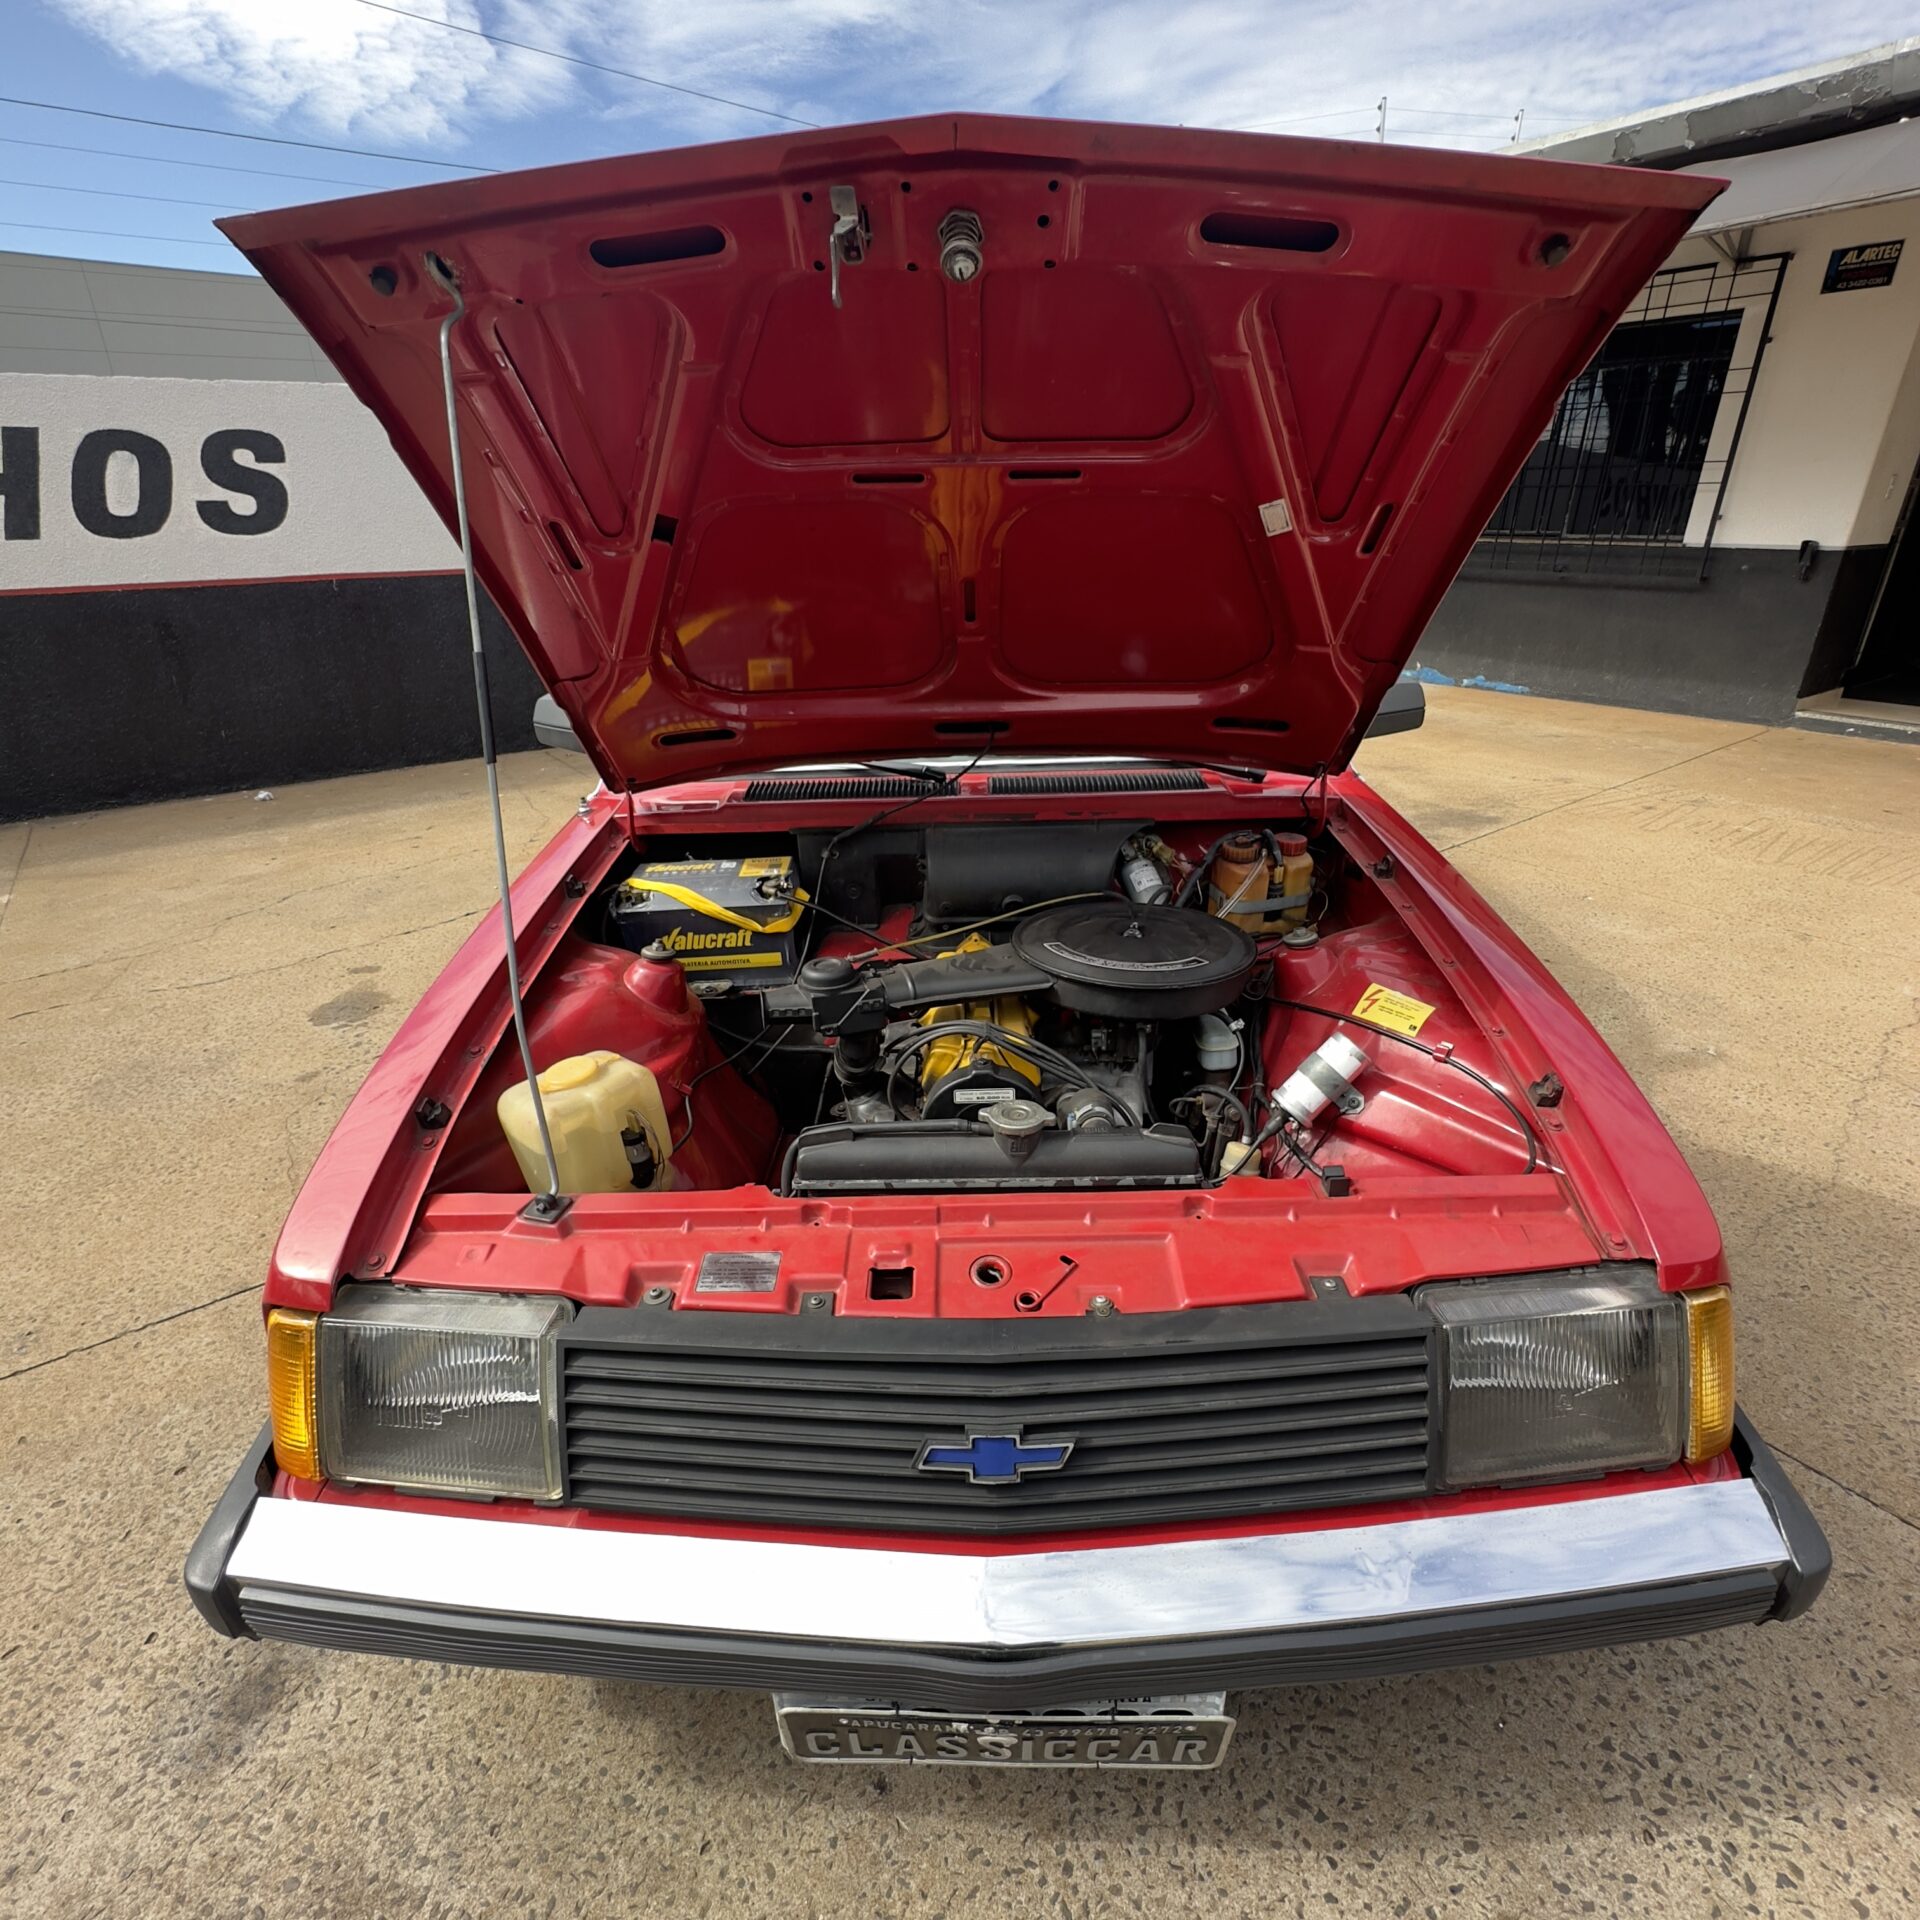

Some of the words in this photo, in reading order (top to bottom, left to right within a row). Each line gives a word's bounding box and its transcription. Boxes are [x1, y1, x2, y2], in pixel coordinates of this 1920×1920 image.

[1840, 243, 1901, 265] ALARTEC
[662, 926, 752, 951] Valucraft
[805, 1731, 1208, 1762] CLASSICCAR
